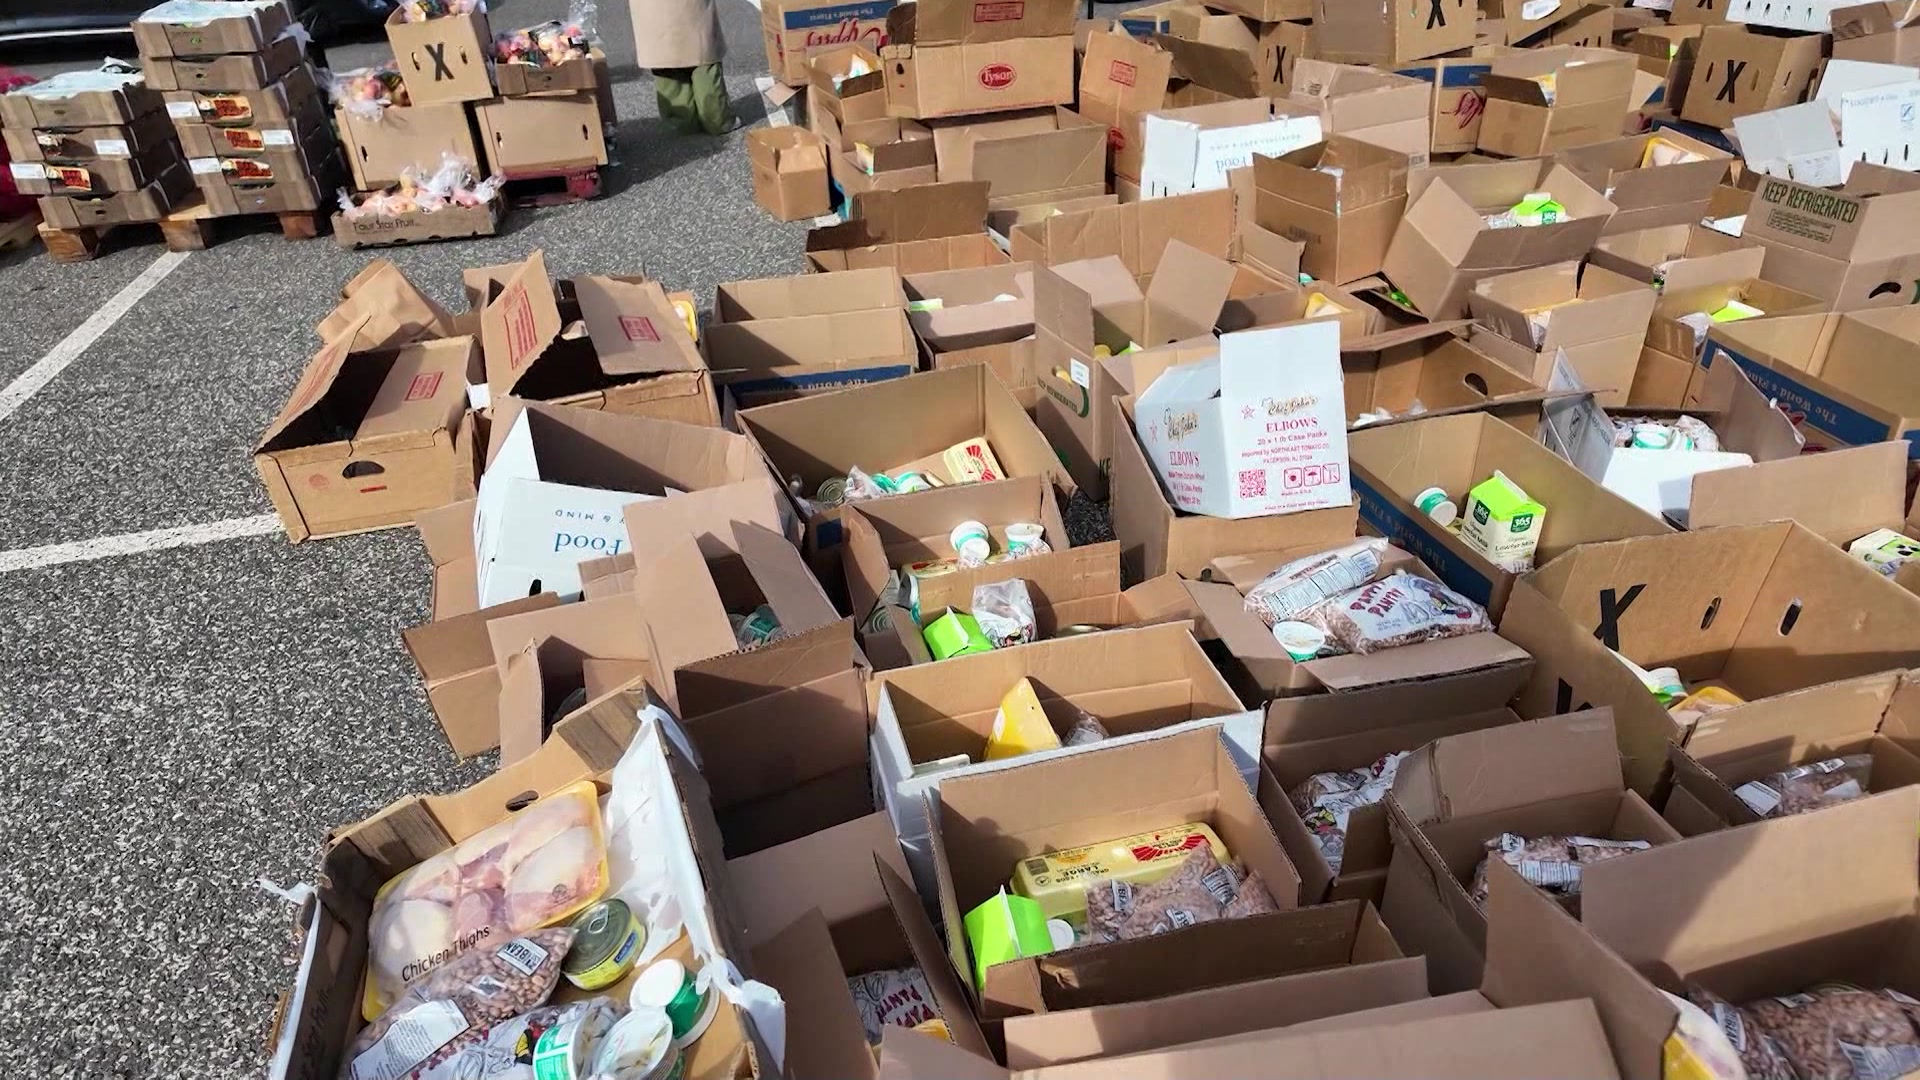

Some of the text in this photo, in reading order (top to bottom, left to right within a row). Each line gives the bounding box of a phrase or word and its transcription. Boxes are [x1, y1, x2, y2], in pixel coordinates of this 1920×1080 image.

[431, 43, 454, 81] X
[1273, 45, 1287, 84] X
[984, 68, 1015, 85] Tyson
[1716, 60, 1747, 103] X
[1761, 180, 1860, 224] KEEP REFRIGERATED
[376, 219, 394, 229] Star
[1815, 405, 1838, 425] The
[1266, 417, 1318, 434] ELBOWS
[1169, 450, 1200, 467] ELBOWS
[555, 509, 594, 521] MIND
[1512, 517, 1531, 528] 365
[554, 532, 623, 556] Food
[1594, 583, 1648, 652] X
[1063, 865, 1099, 877] LARGE
[402, 926, 490, 982] Chicken Thighs
